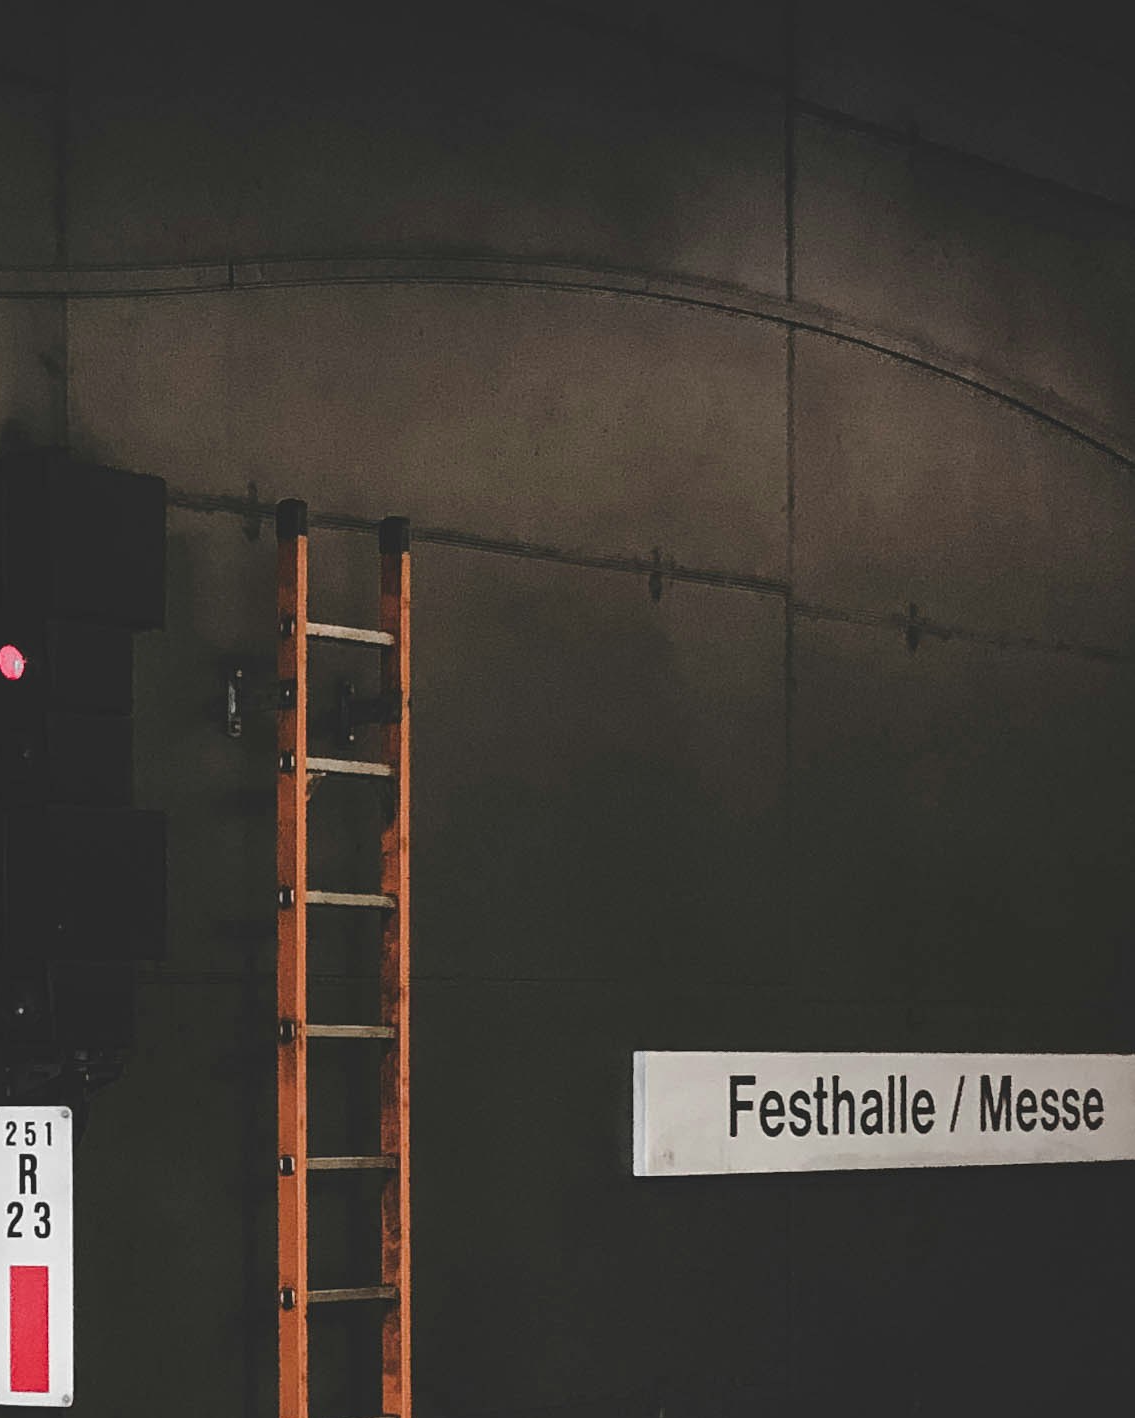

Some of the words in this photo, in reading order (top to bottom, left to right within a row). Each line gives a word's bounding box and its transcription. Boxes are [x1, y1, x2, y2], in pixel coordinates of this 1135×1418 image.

[729, 1074, 936, 1137] Festhalle
[949, 1074, 966, 1133] /
[979, 1074, 1105, 1132] Messe
[5, 1121, 52, 1147] 251
[18, 1153, 38, 1195] R
[6, 1201, 52, 1239] 23
